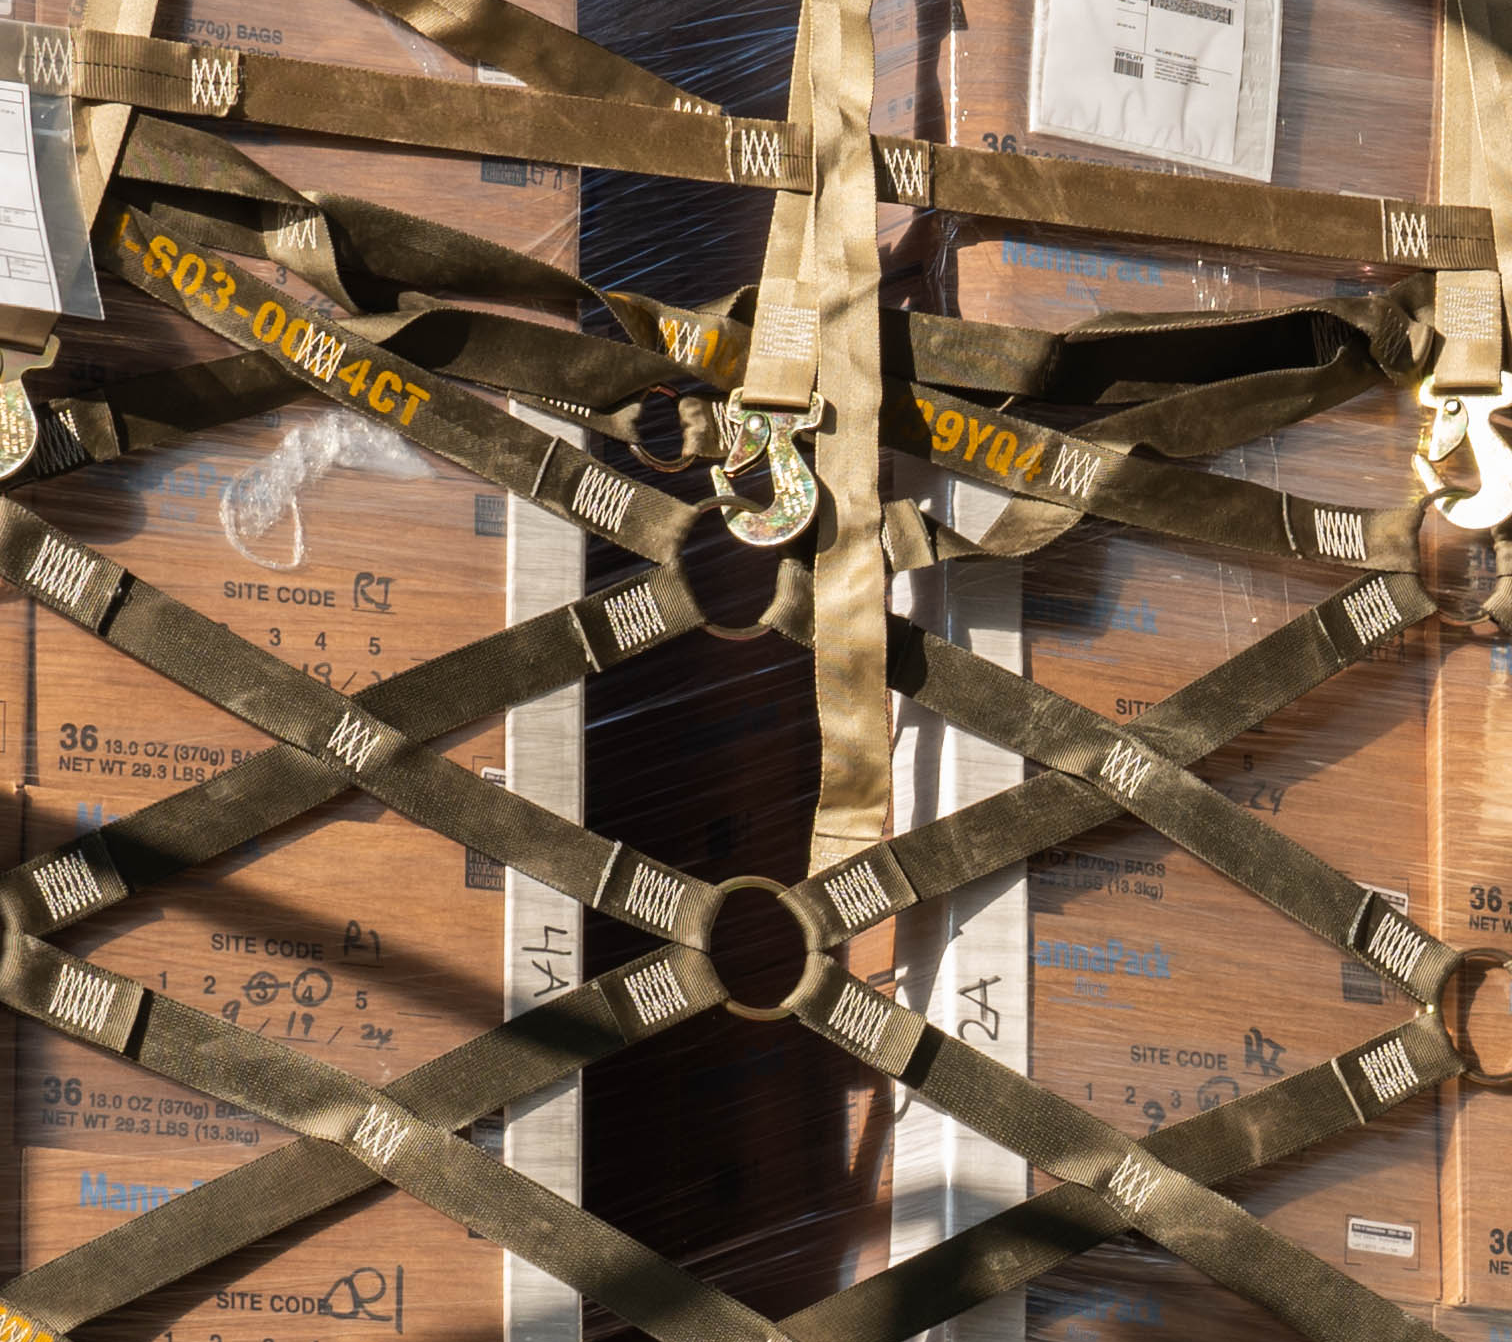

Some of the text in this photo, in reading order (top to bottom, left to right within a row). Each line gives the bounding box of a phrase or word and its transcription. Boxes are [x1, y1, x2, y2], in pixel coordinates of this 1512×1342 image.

[237, 25, 283, 46] BAGS
[1001, 234, 1164, 287] MannaPack
[223, 580, 336, 608] SITE CODE
[269, 627, 382, 657] 3 4 5
[59, 723, 226, 765] 36 13.0 OZ (370g)
[58, 756, 207, 783] NET WT 29.3 LBS
[1125, 859, 1166, 877] BAGS
[1469, 885, 1503, 913] 36
[1469, 914, 1501, 932] NET
[211, 933, 324, 961] SITE CODE
[1035, 938, 1172, 979] annaPack
[522, 925, 572, 999] 4A
[158, 971, 368, 1010] 1 2 5
[1074, 977, 1109, 999] Rice
[1130, 1044, 1228, 1071] SITE CODE
[43, 1076, 211, 1121] 36 13.0 OZ (370g)
[1085, 1082, 1182, 1109] 1 2 3
[41, 1108, 260, 1147] NET WT 29.3 LBS (13.3kg)
[215, 1290, 264, 1312] SITE
